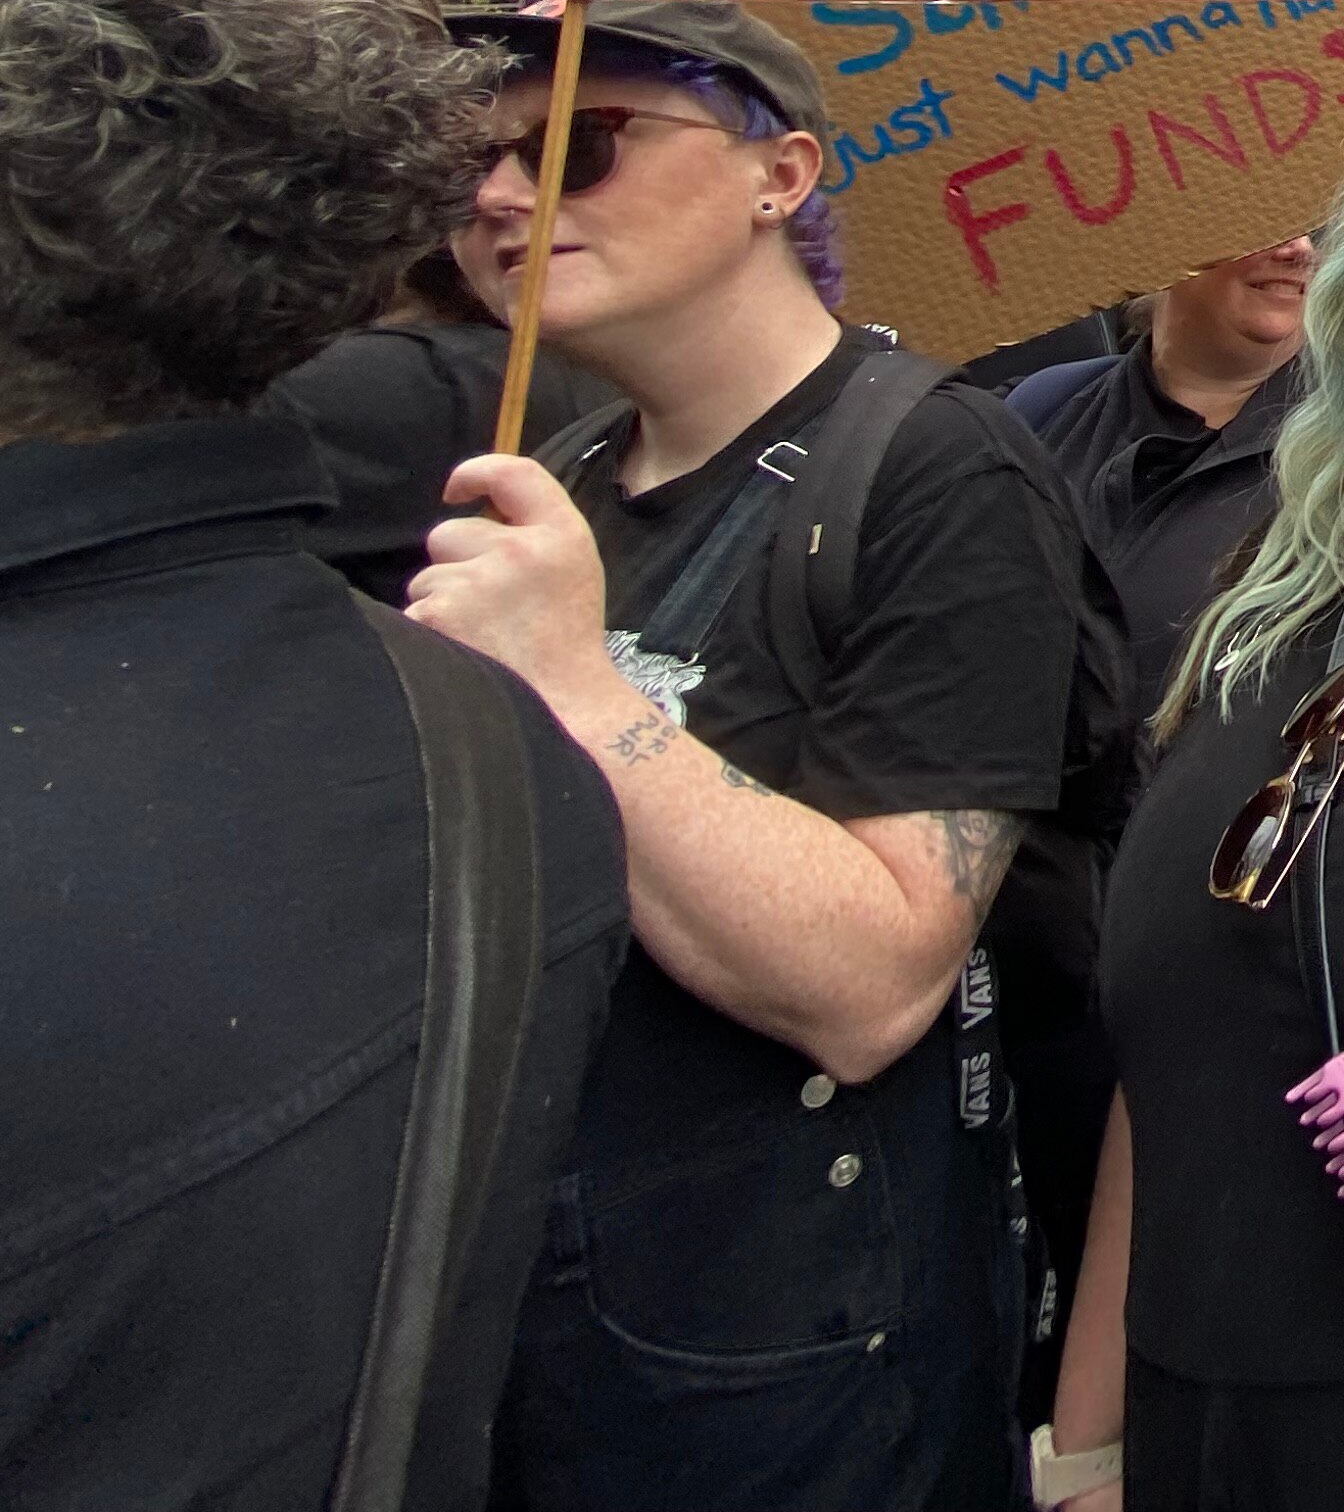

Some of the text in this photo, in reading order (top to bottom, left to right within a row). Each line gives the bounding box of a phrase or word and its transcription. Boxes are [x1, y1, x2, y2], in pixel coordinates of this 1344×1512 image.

[822, 77, 954, 194] just
[996, 0, 1242, 103] wanna
[961, 947, 993, 1031] VANS
